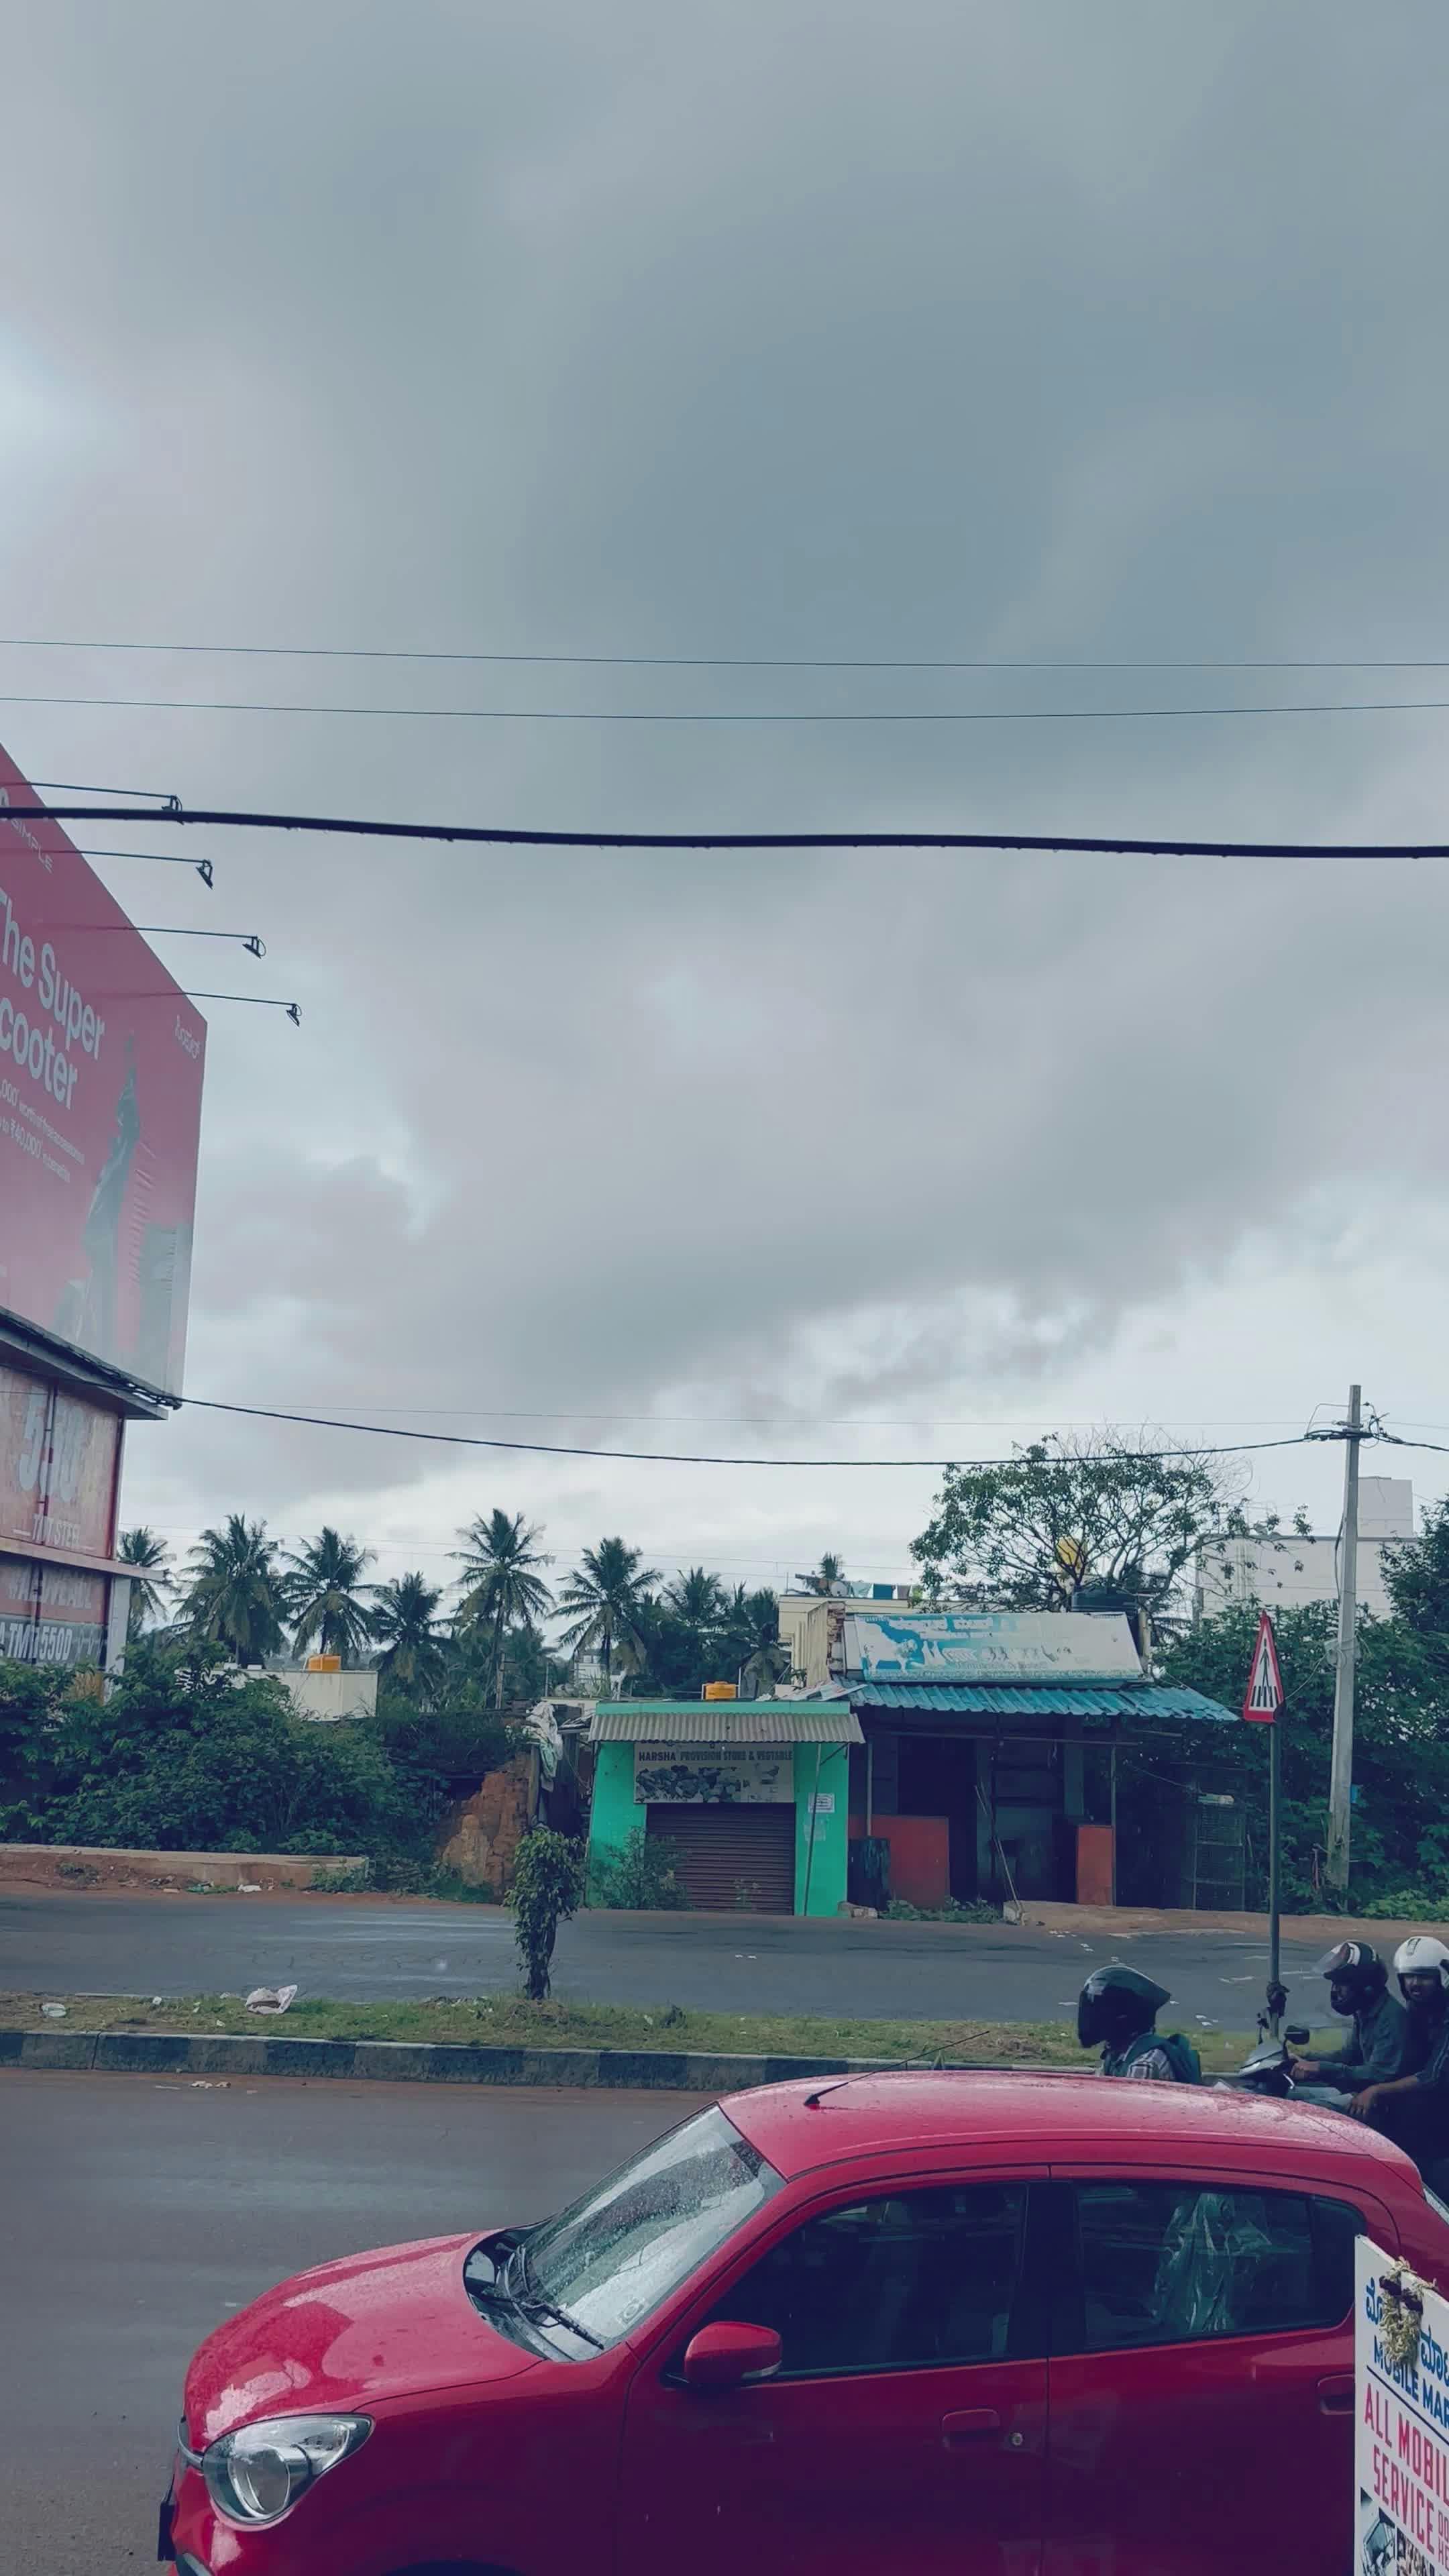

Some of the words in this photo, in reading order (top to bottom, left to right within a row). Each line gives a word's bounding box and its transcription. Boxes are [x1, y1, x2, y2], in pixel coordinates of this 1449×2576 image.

[38, 943, 105, 1061] Super
[39, 1625, 72, 1662] 550D
[639, 1750, 676, 1761] HARSHA
[1364, 2382, 1392, 2449] ALL
[1373, 2443, 1434, 2555] SERVICE
